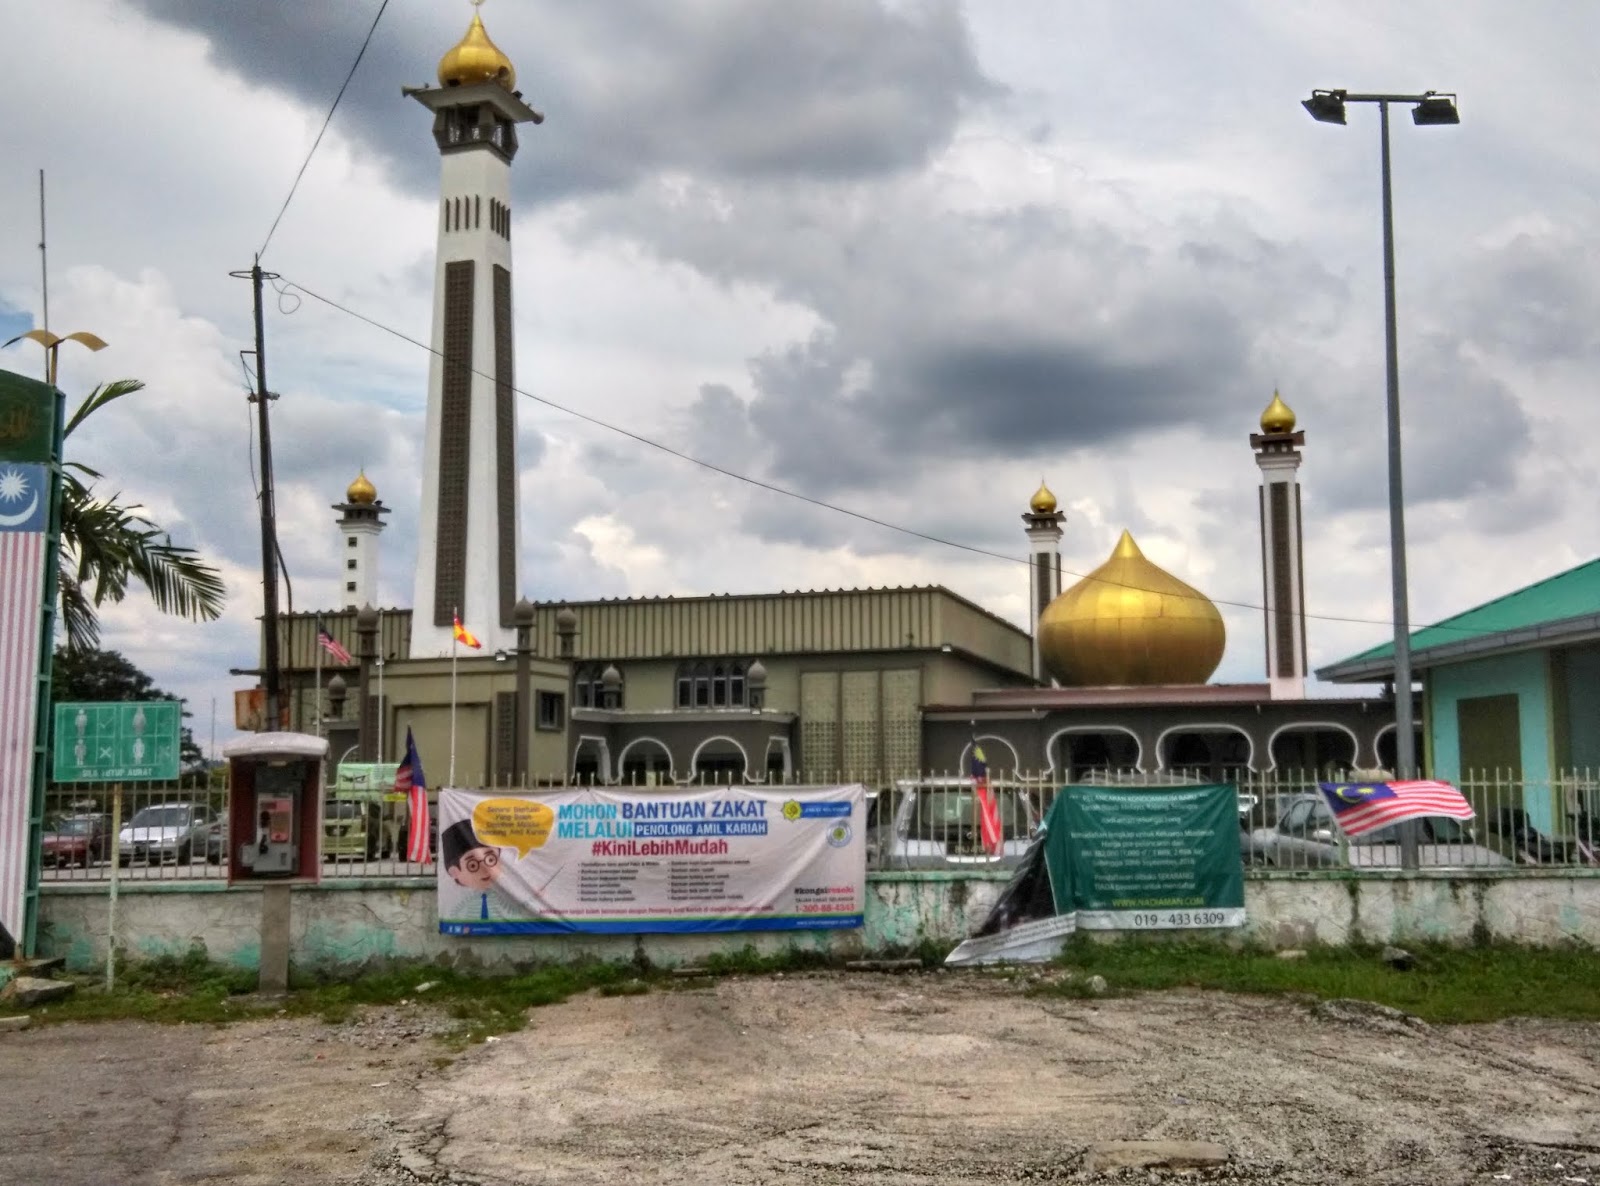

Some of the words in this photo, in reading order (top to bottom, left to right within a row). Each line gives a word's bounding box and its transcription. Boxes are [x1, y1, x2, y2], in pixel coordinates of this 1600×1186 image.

[558, 804, 617, 820] MOHON
[622, 801, 706, 820] BANTUAN
[711, 800, 767, 818] ZAKAT
[558, 821, 633, 839] MELALUI
[635, 823, 694, 836] PENOLONG
[696, 823, 723, 835] AMIL
[725, 822, 767, 834] KARIAH
[591, 839, 729, 857] #KiniLebihMudah
[1134, 914, 1159, 927] 019
[1168, 913, 1191, 926] 433
[1193, 912, 1225, 925] 6309
